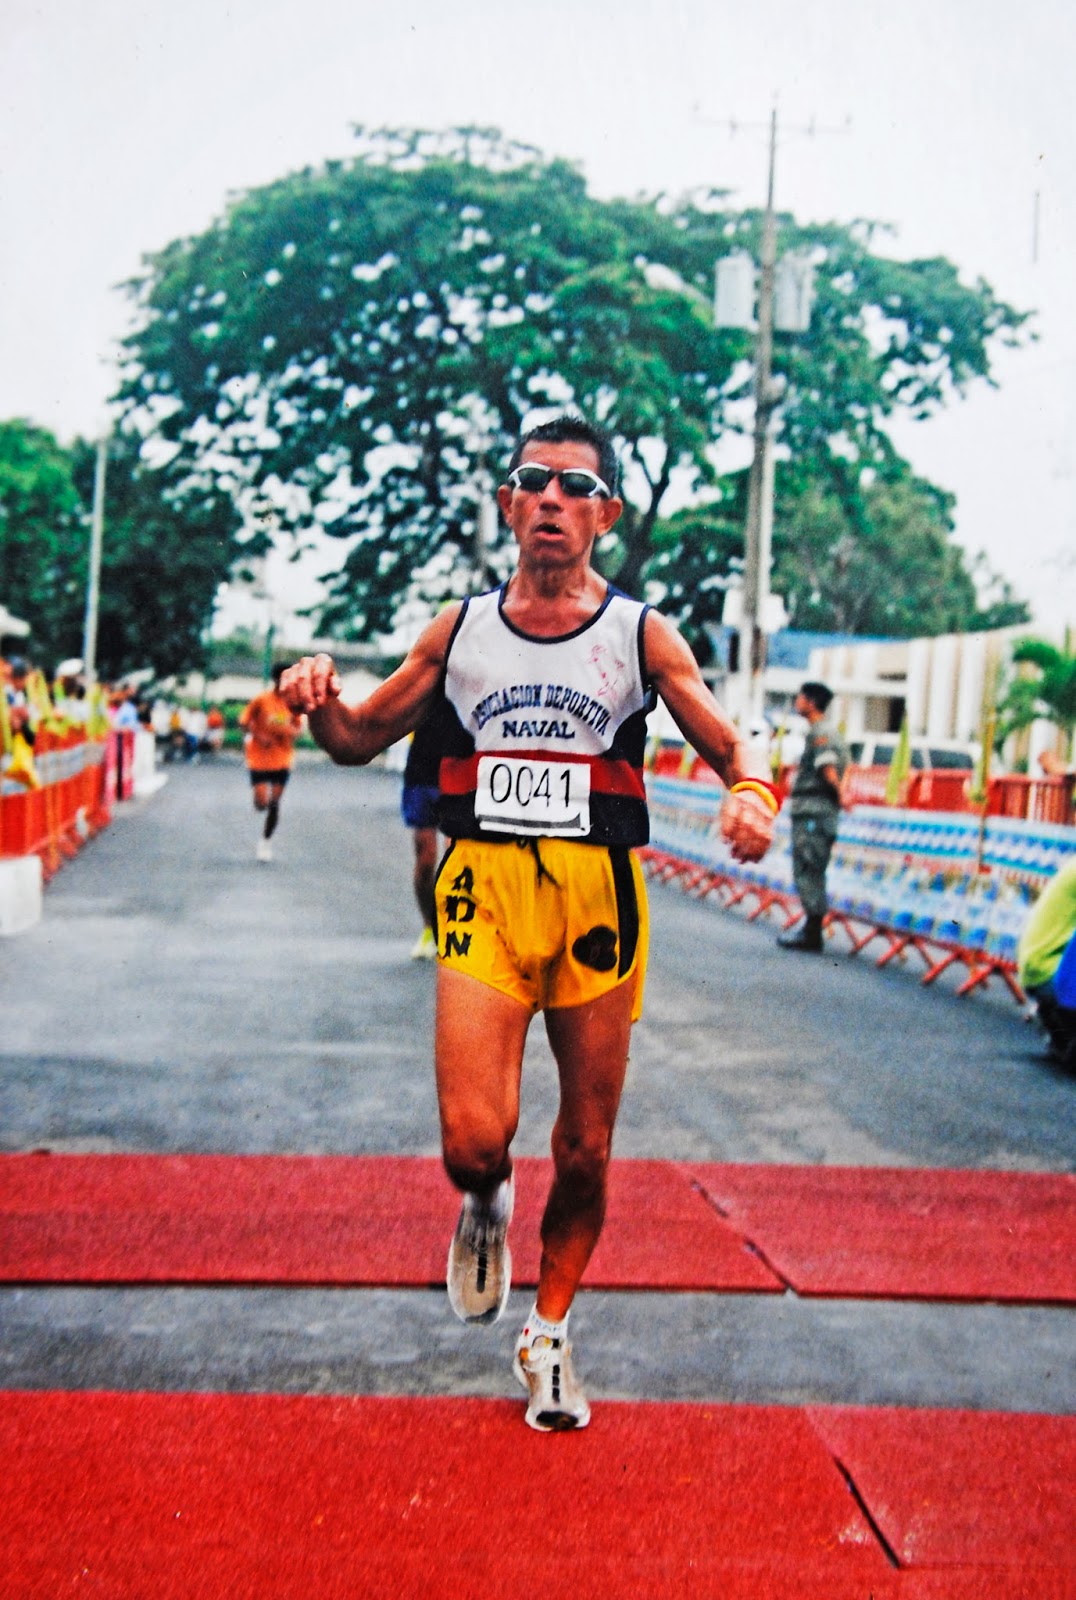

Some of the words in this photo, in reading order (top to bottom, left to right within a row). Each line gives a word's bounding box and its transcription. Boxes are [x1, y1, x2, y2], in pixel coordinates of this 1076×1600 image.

[502, 720, 575, 739] NAVAL
[545, 684, 611, 736] DEPORTIVA
[490, 763, 572, 808] 0041
[444, 866, 476, 959] ADN
